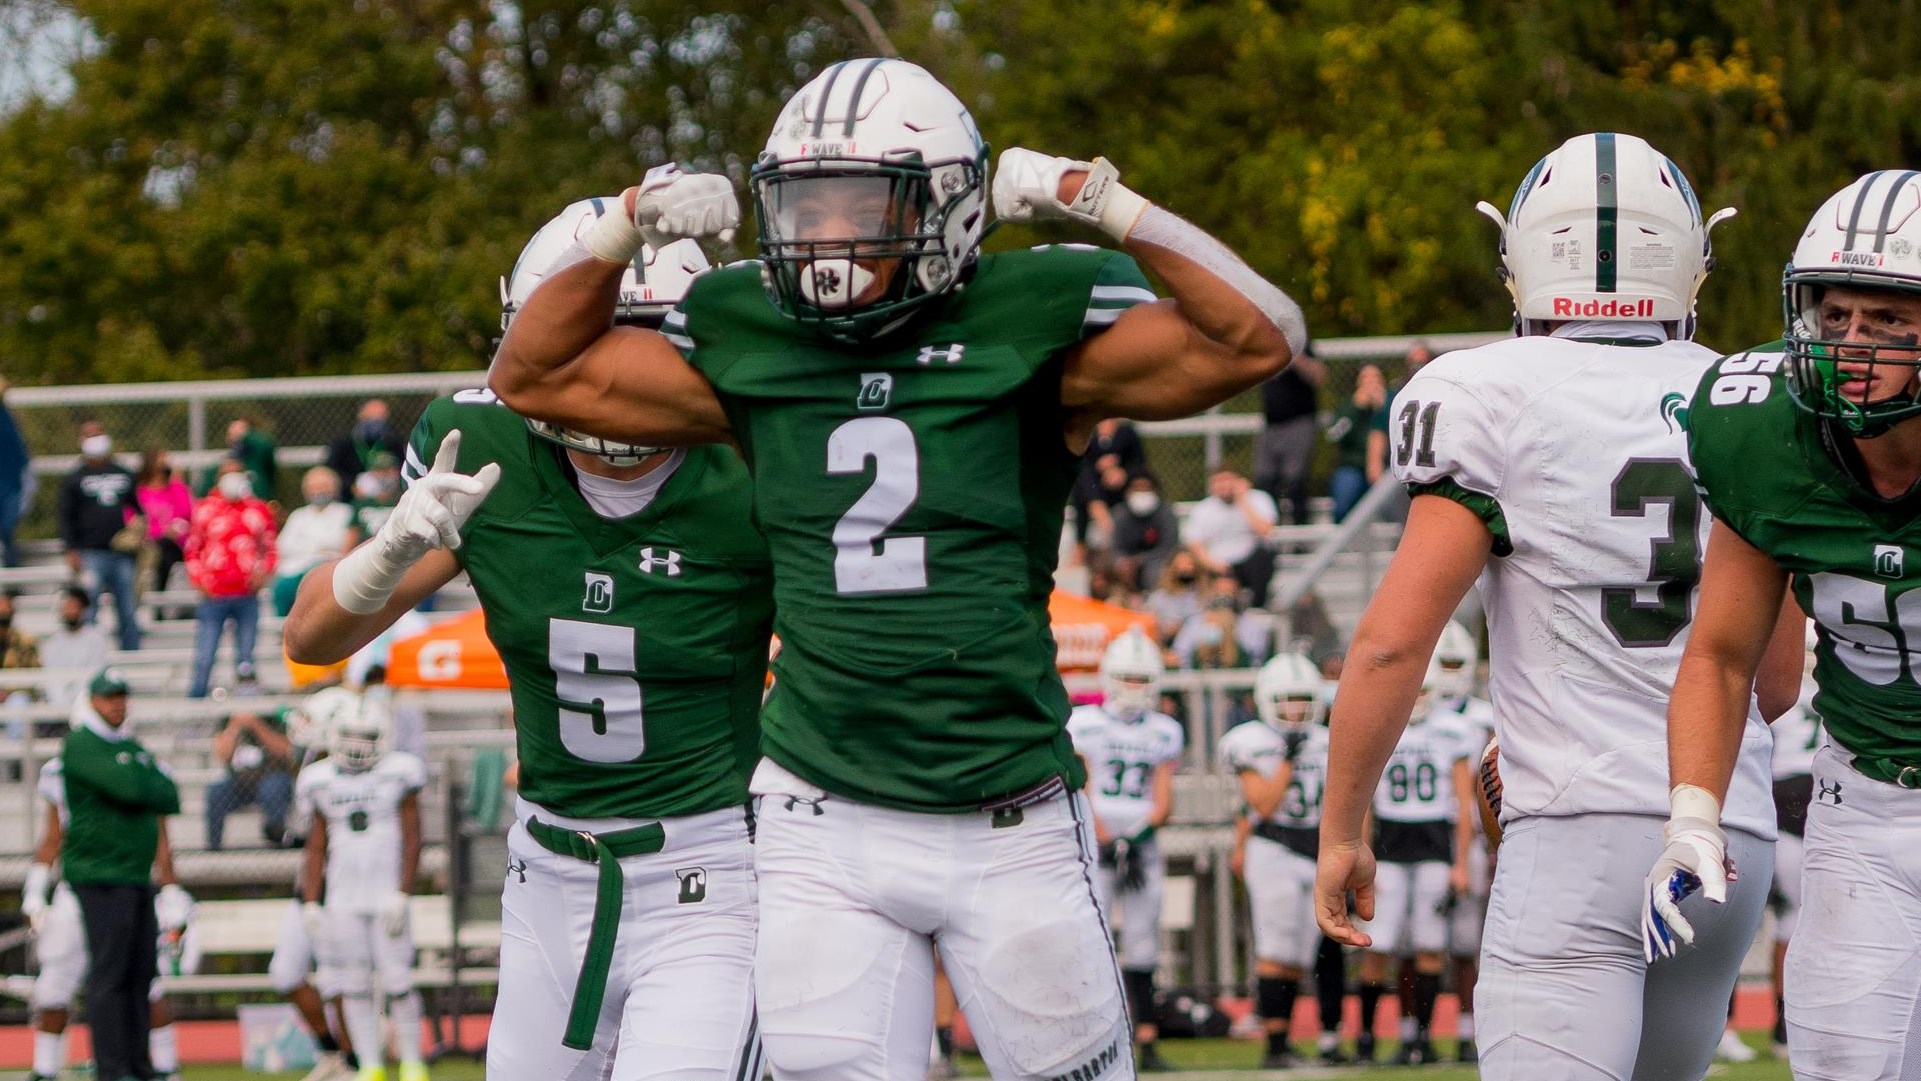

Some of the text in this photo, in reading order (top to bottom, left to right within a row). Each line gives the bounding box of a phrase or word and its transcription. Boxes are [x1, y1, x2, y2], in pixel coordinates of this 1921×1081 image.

[812, 143, 843, 155] WAVE
[1841, 252, 1876, 267] WAVE
[1553, 297, 1653, 317] Riddell
[1709, 351, 1786, 407] 56
[1397, 399, 1441, 468] 31
[827, 416, 928, 593] 2
[1600, 457, 1714, 648] 3
[1808, 570, 1921, 686] 5
[548, 617, 645, 764] 5
[1102, 758, 1151, 799] 33
[1388, 762, 1437, 803] 80
[1050, 1039, 1118, 1081] BARTON
